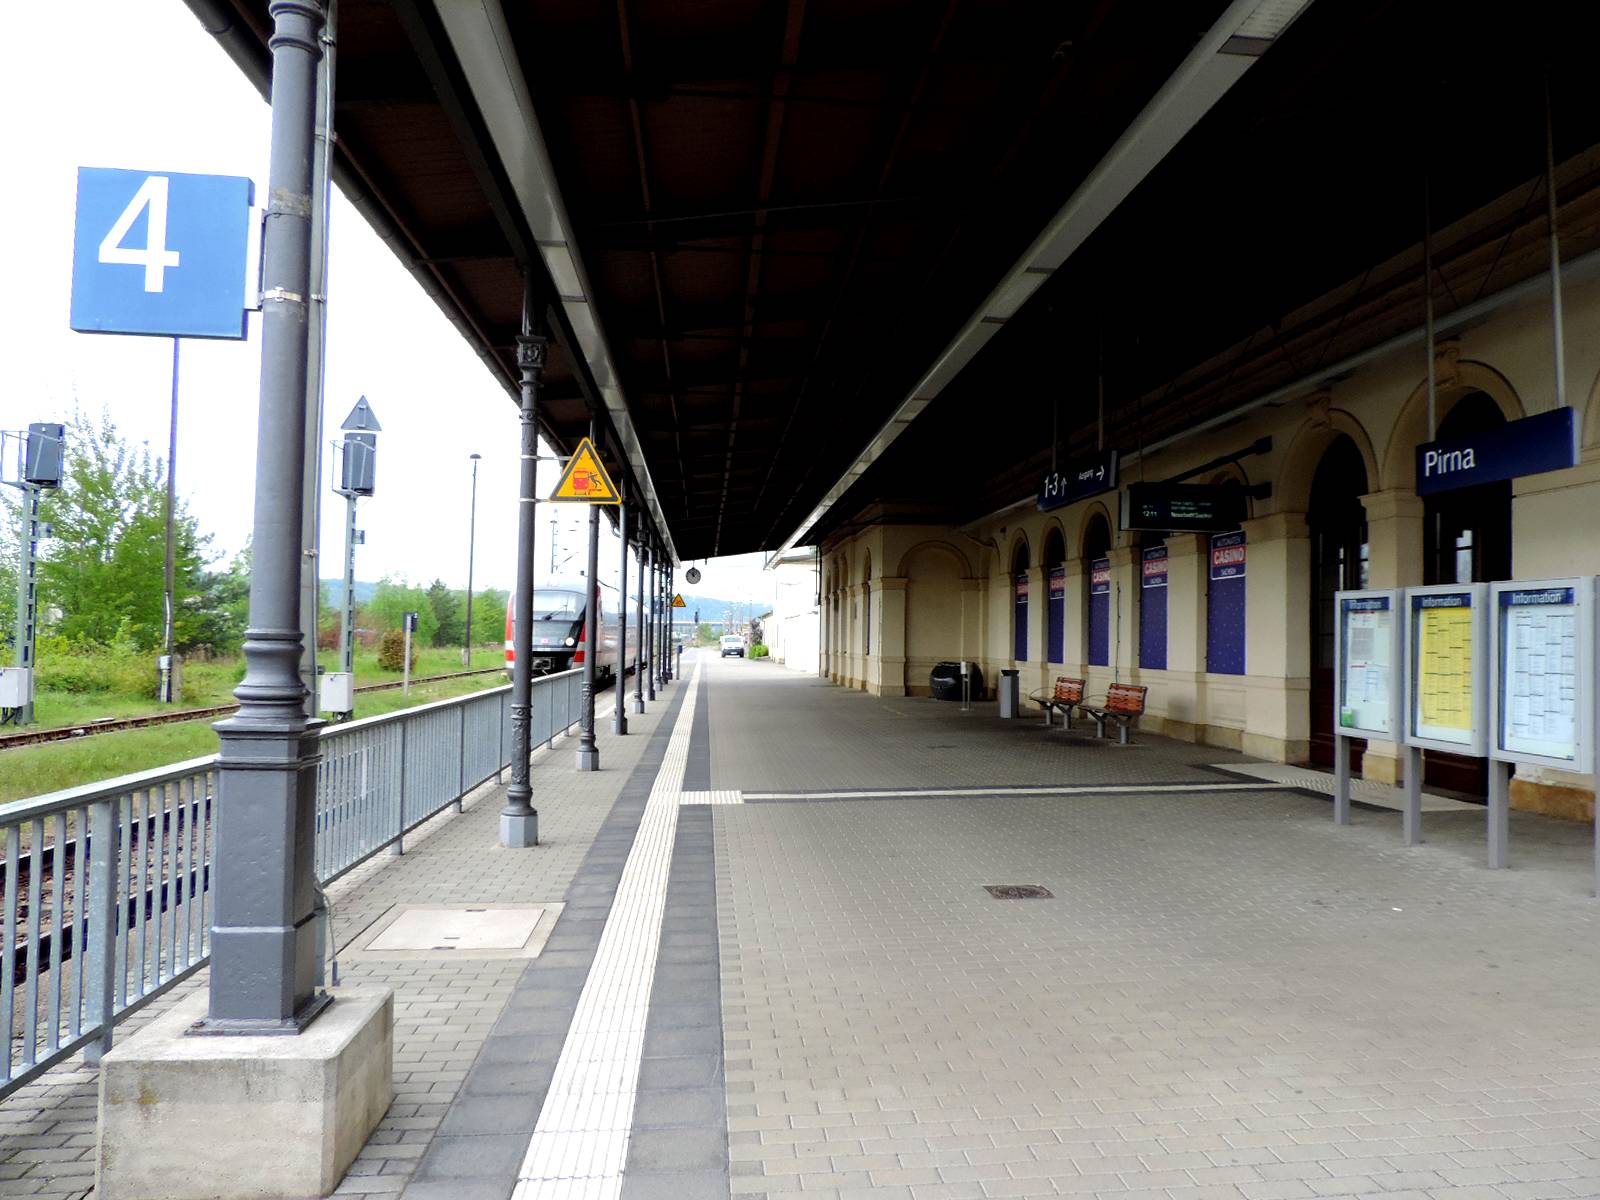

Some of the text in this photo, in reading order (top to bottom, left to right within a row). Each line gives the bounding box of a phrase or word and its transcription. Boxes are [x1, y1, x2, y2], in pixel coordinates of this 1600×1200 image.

[98, 175, 180, 293] 4
[1425, 448, 1476, 477] Pirna
[1044, 472, 1059, 499] 1-3
[1214, 547, 1245, 565] CASINO
[1422, 597, 1462, 608] Information
[1512, 592, 1562, 605] Information
